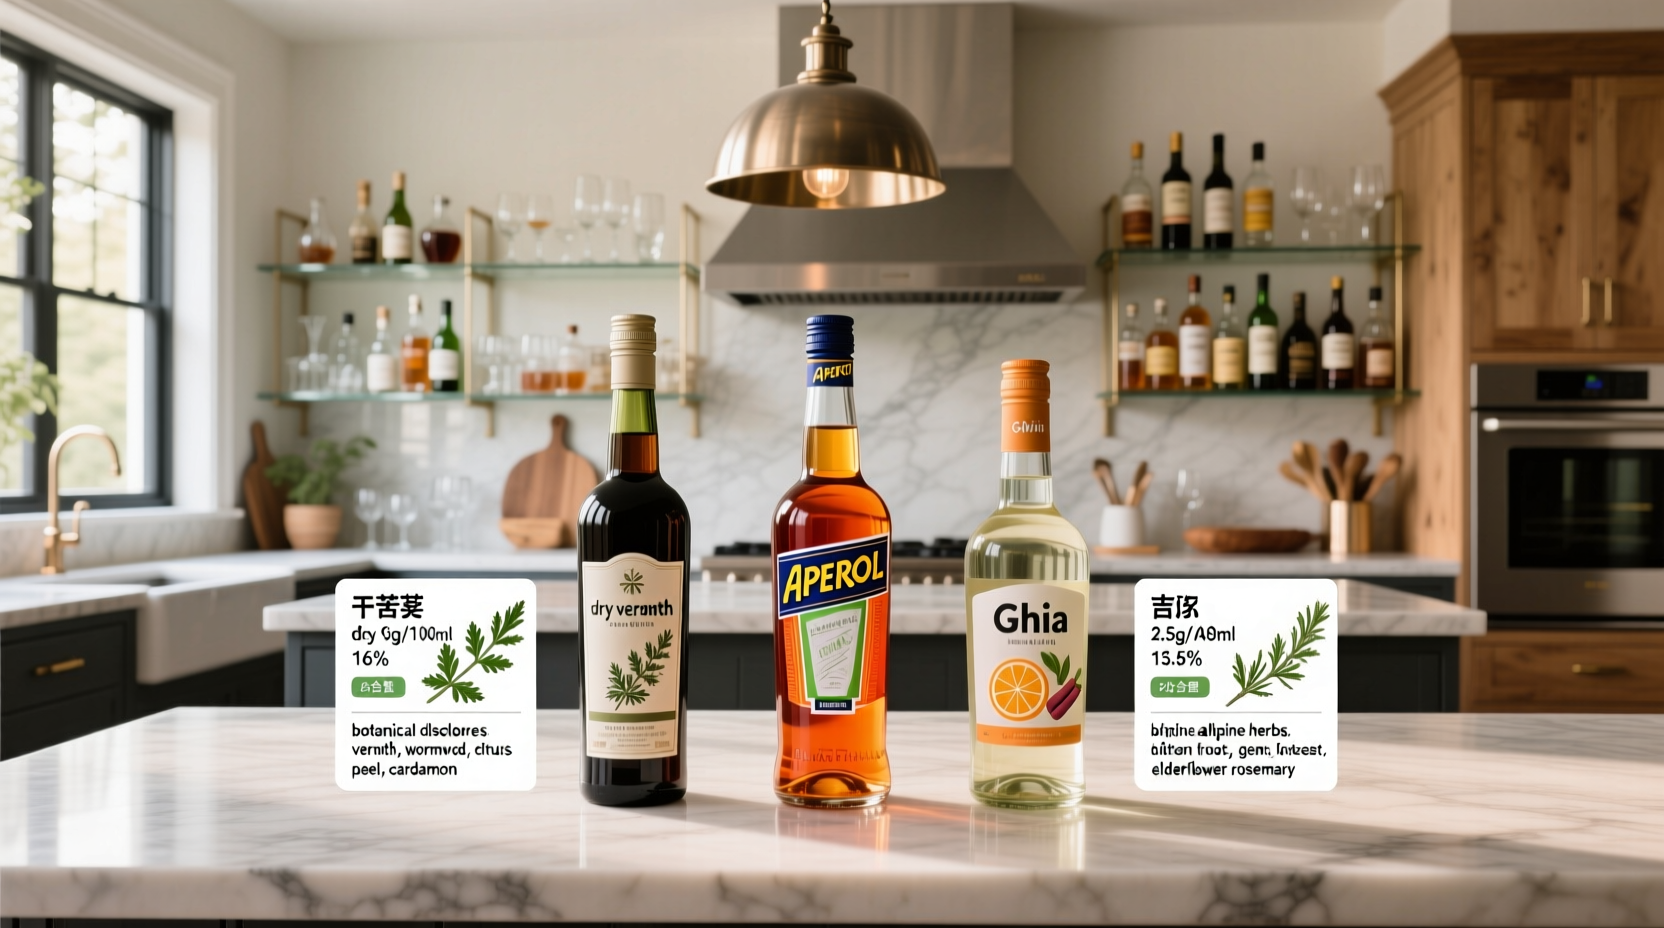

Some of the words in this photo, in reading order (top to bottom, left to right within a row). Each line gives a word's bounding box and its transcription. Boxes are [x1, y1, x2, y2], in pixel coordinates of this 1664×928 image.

[782, 551, 884, 604] APEROL
[591, 599, 614, 621] dry
[993, 601, 1068, 634] Ghia
